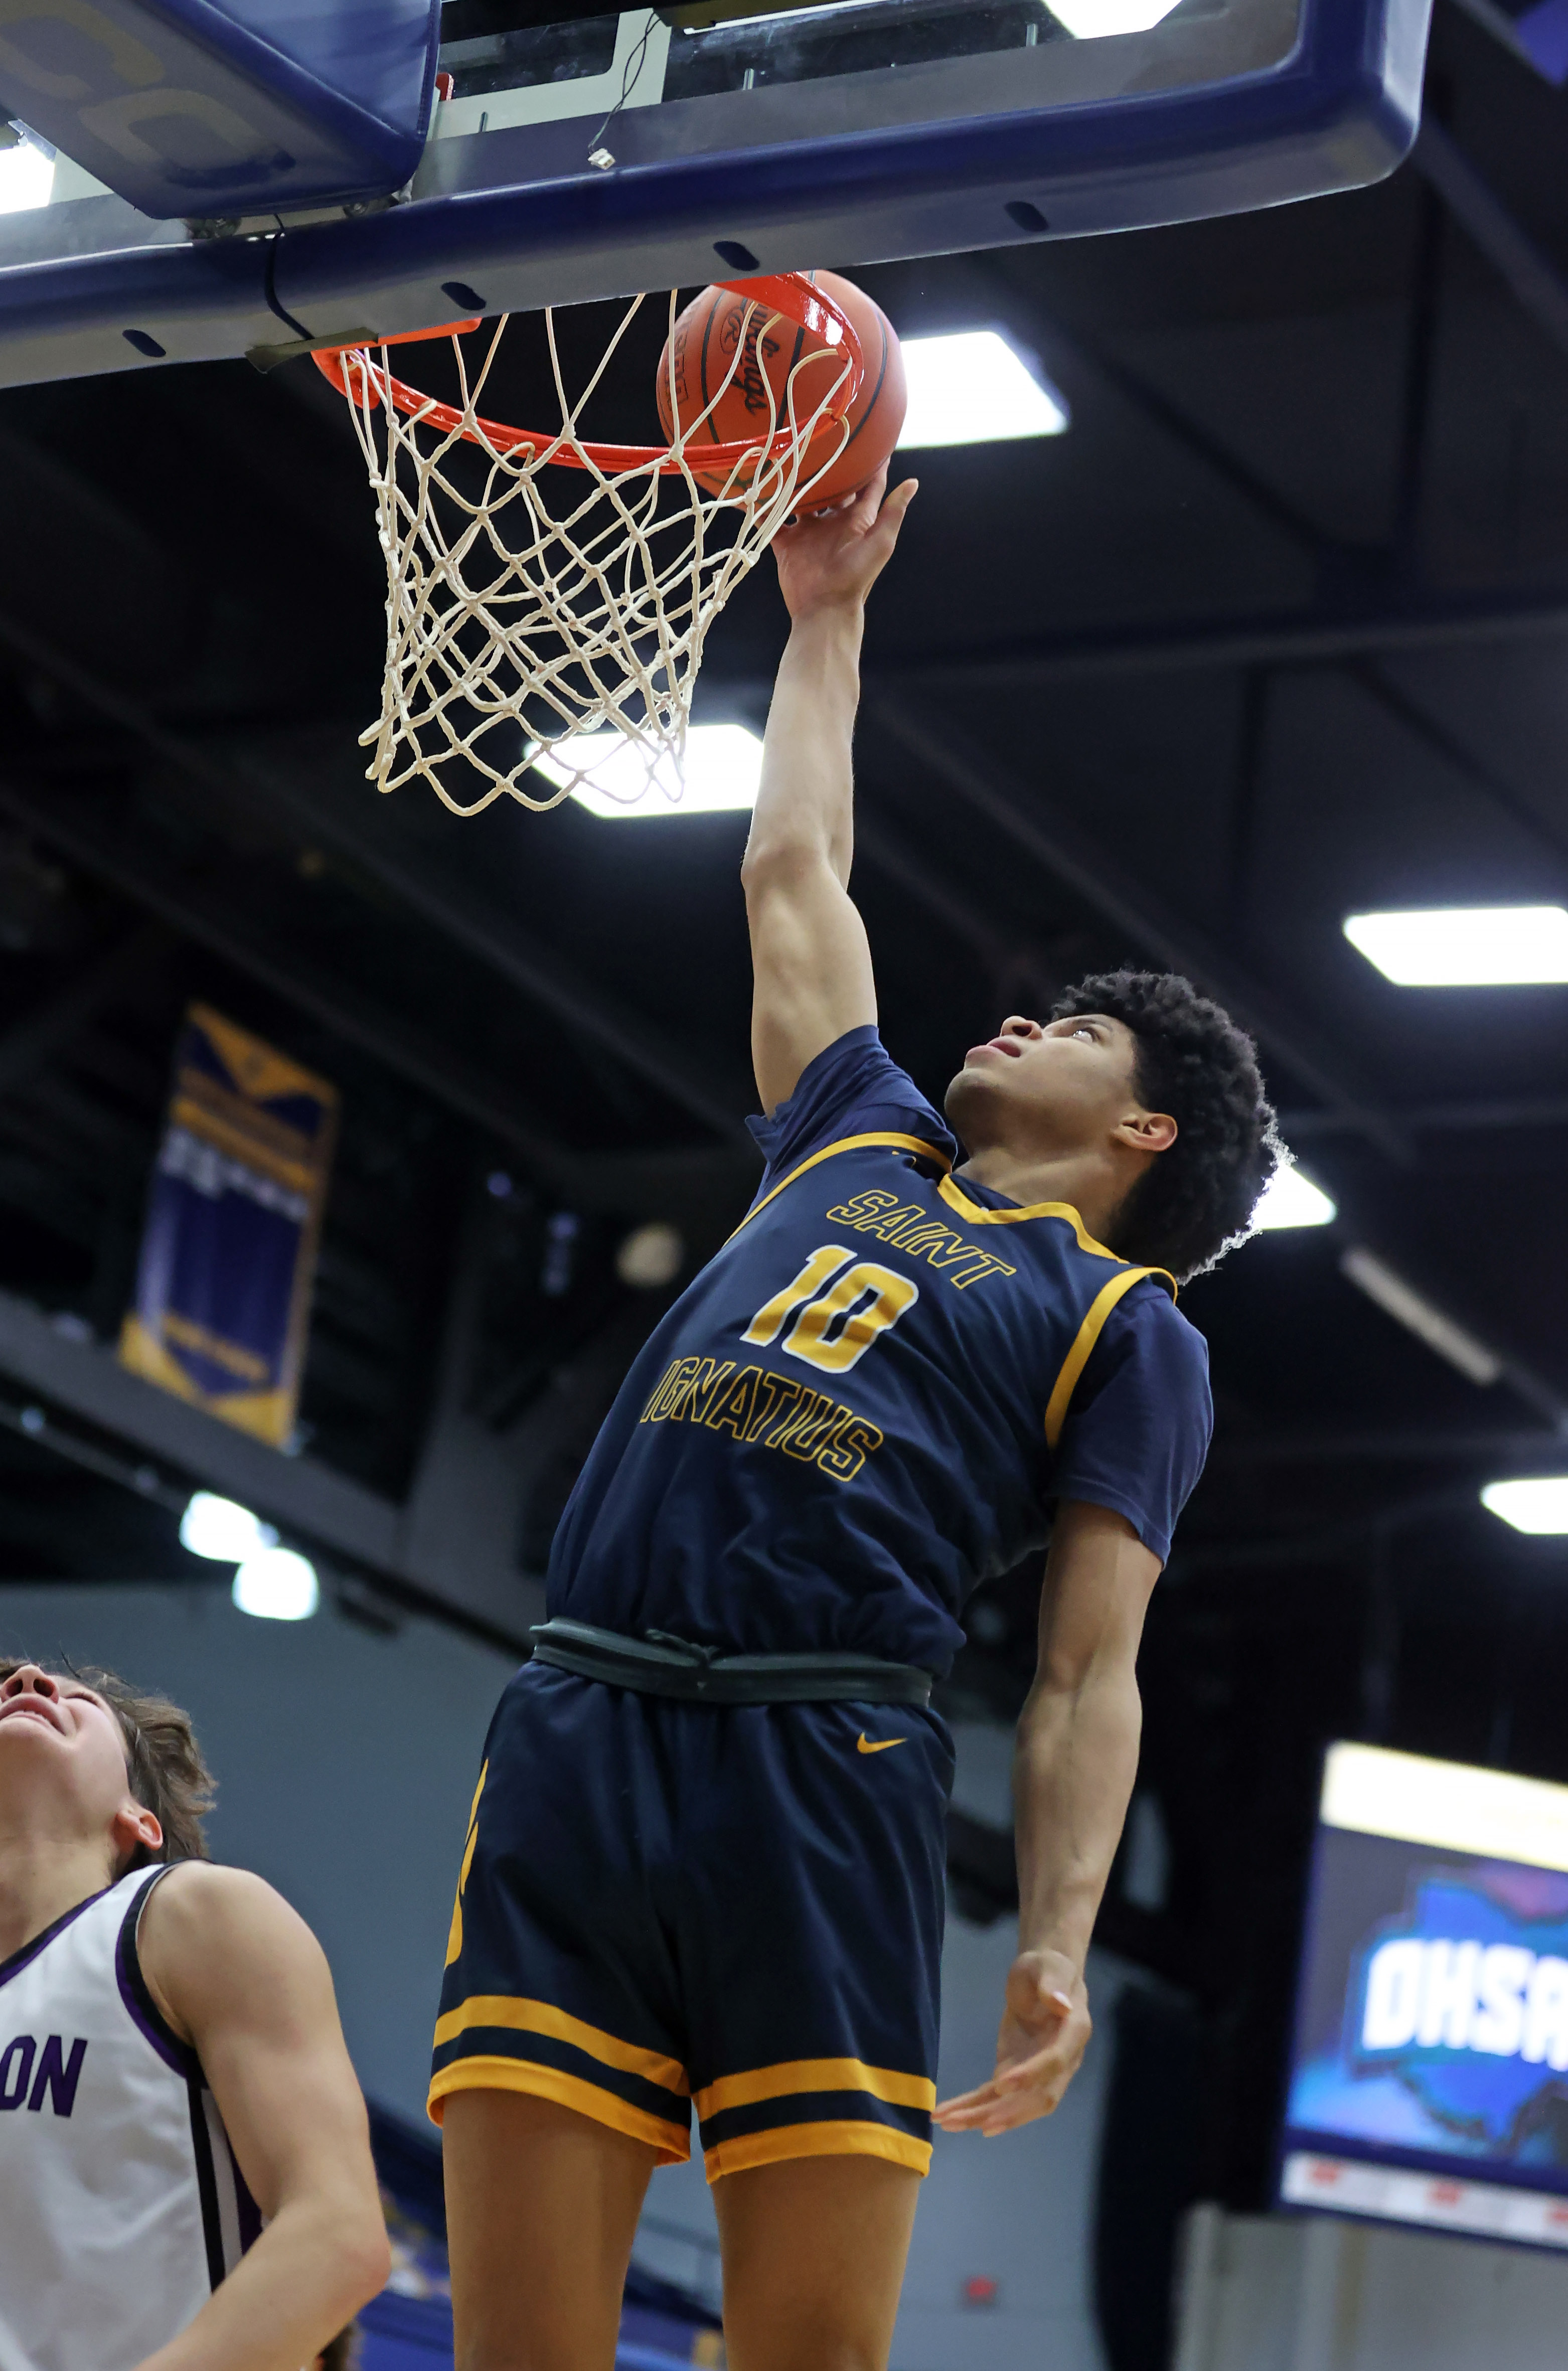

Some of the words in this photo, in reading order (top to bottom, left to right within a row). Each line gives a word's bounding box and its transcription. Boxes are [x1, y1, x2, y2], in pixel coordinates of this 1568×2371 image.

[826, 1189, 1017, 1290] SAINT
[739, 1244, 919, 1374] 10
[639, 1357, 884, 1483] IGNATIUS
[0, 2034, 88, 2118] ON
